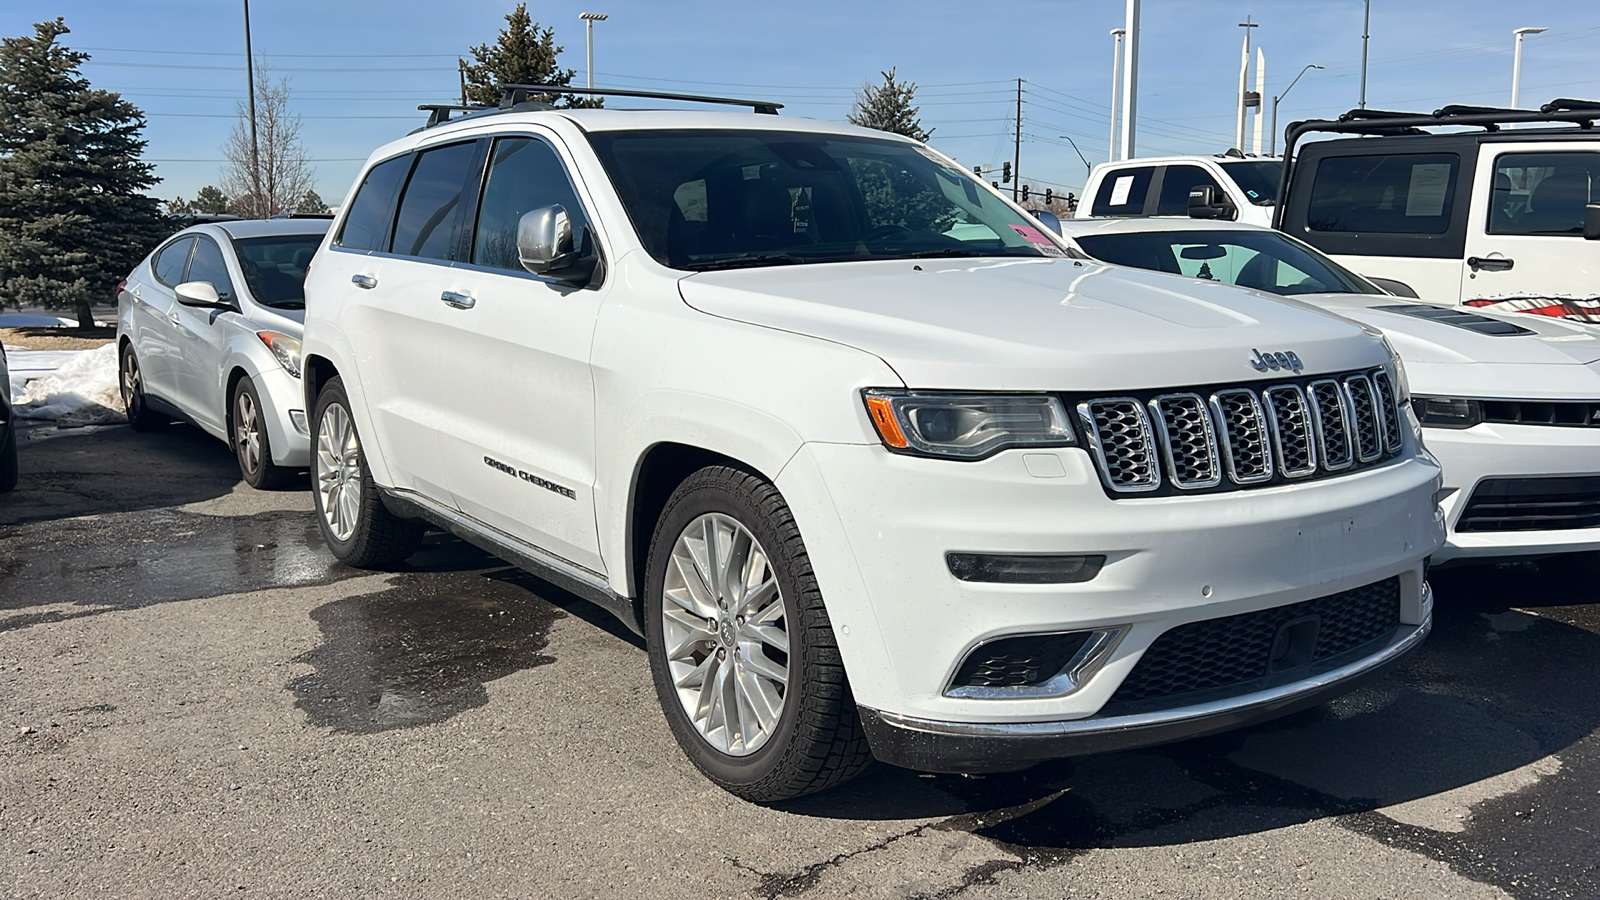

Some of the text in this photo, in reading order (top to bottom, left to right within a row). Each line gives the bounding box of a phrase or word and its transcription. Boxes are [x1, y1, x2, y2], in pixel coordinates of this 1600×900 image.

[1249, 347, 1304, 375] Jeep
[483, 455, 577, 501] GRAND CHEROKEE
